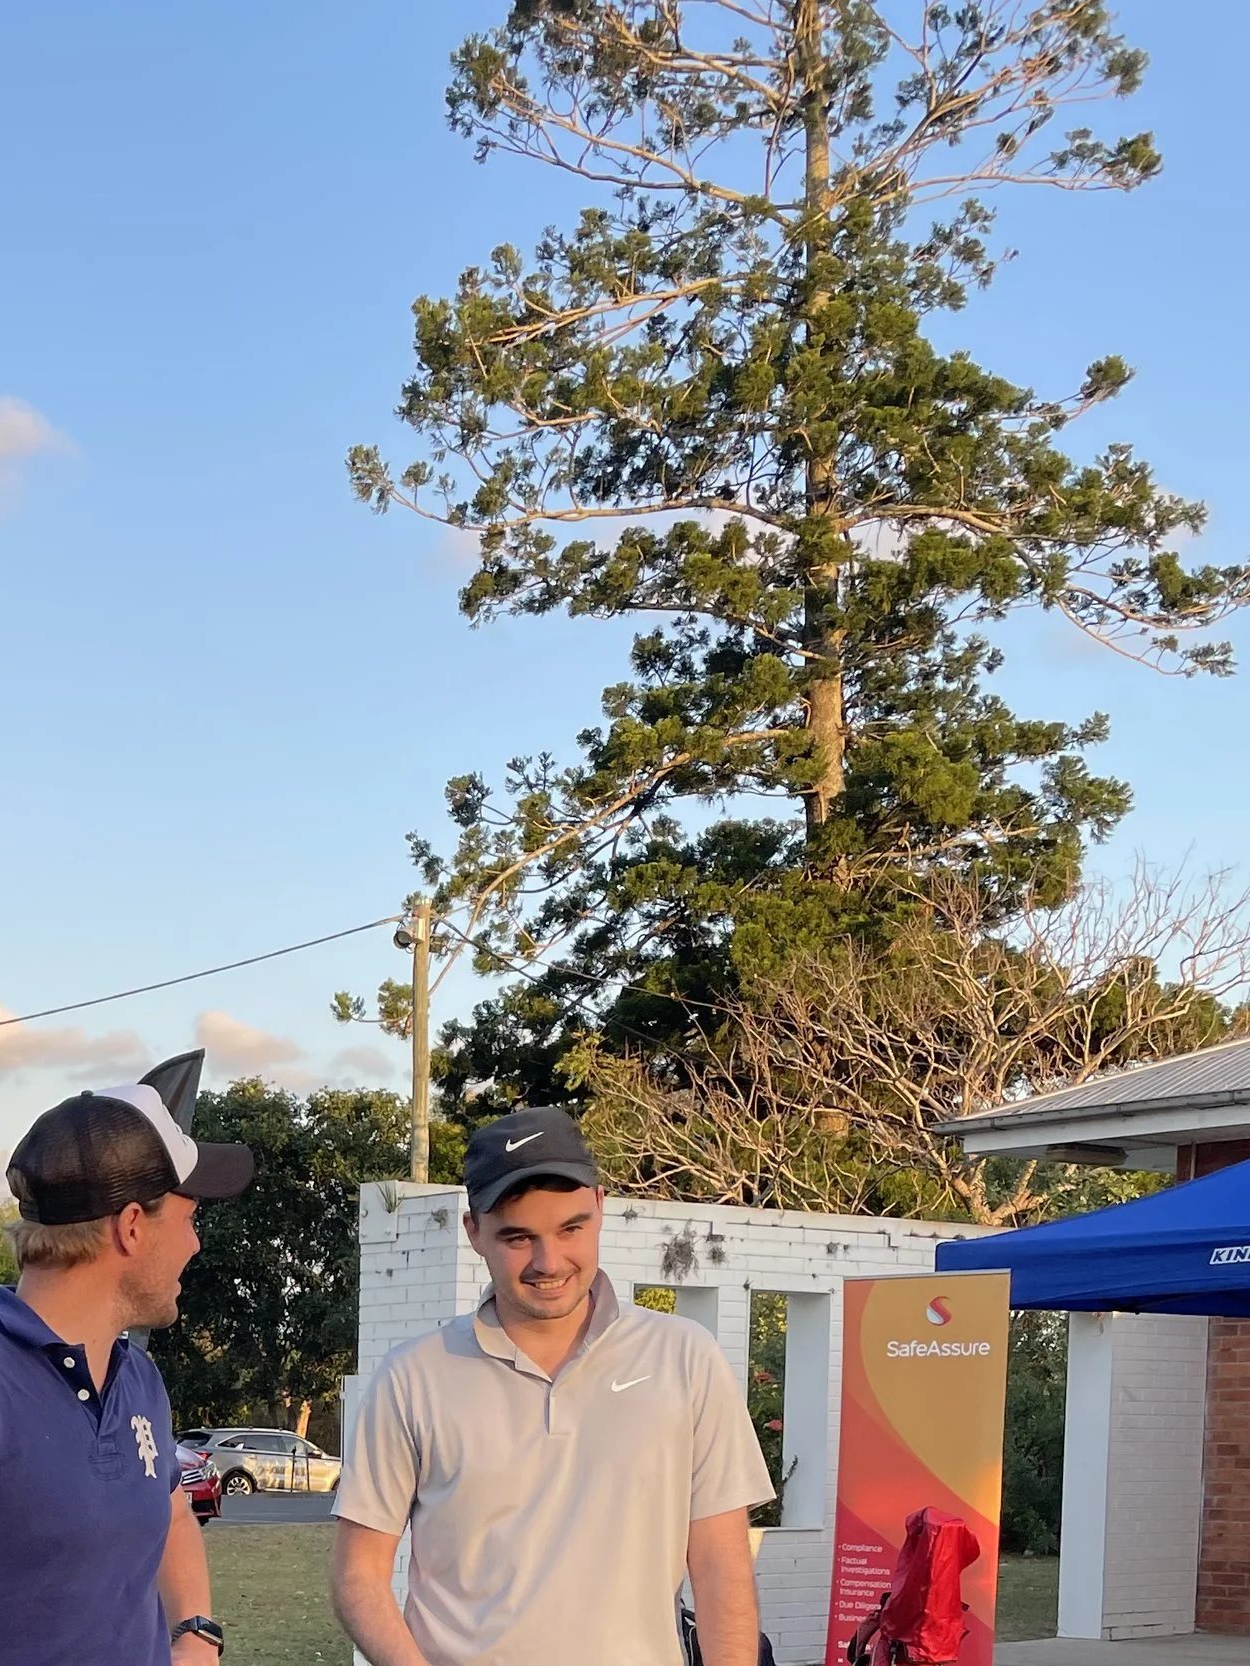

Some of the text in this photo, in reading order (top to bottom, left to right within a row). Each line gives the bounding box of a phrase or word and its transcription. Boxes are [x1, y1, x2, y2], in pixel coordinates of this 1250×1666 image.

[1209, 1245, 1250, 1265] KIN
[886, 1340, 991, 1357] SafeAssure
[841, 1543, 883, 1553] Compliance
[840, 1556, 868, 1565] Factual
[840, 1566, 891, 1576] Investigations
[839, 1578, 892, 1589] Compensation
[839, 1588, 875, 1597] Insurance
[839, 1600, 854, 1609] Due
